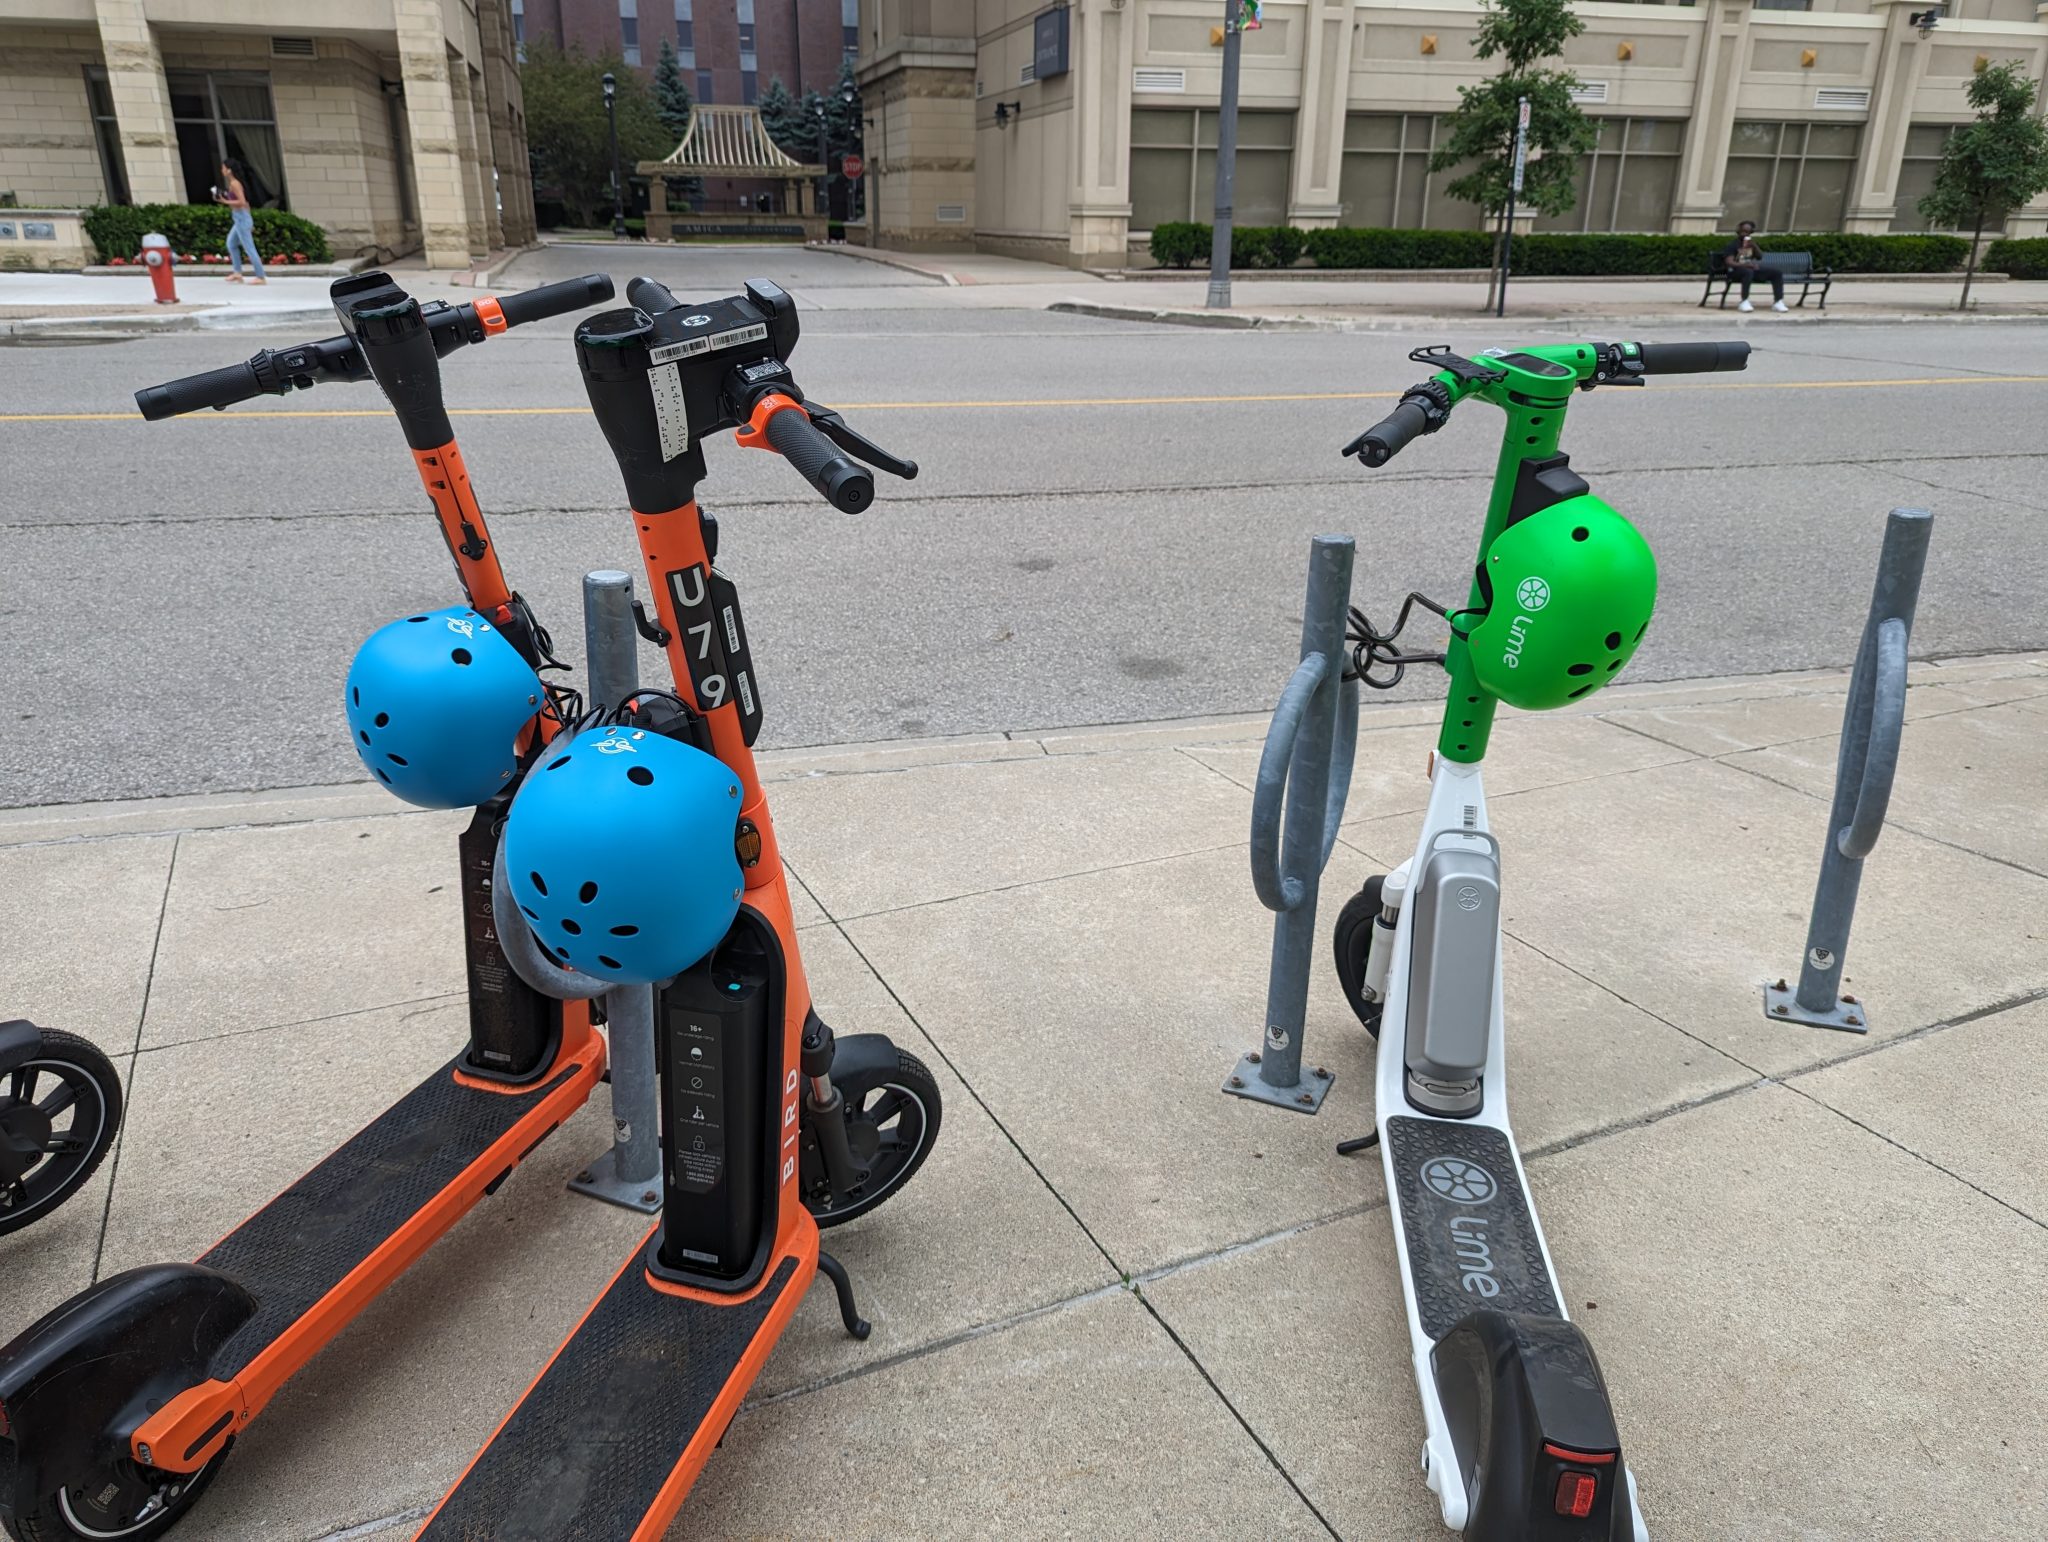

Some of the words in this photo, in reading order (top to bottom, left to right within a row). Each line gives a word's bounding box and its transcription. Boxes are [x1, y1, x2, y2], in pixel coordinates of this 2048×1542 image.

[844, 162, 863, 171] STOP
[1503, 615, 1534, 669] Lime
[690, 1024, 702, 1032] 16+
[783, 1067, 798, 1186] BIRD
[1449, 1217, 1502, 1299] Lime
